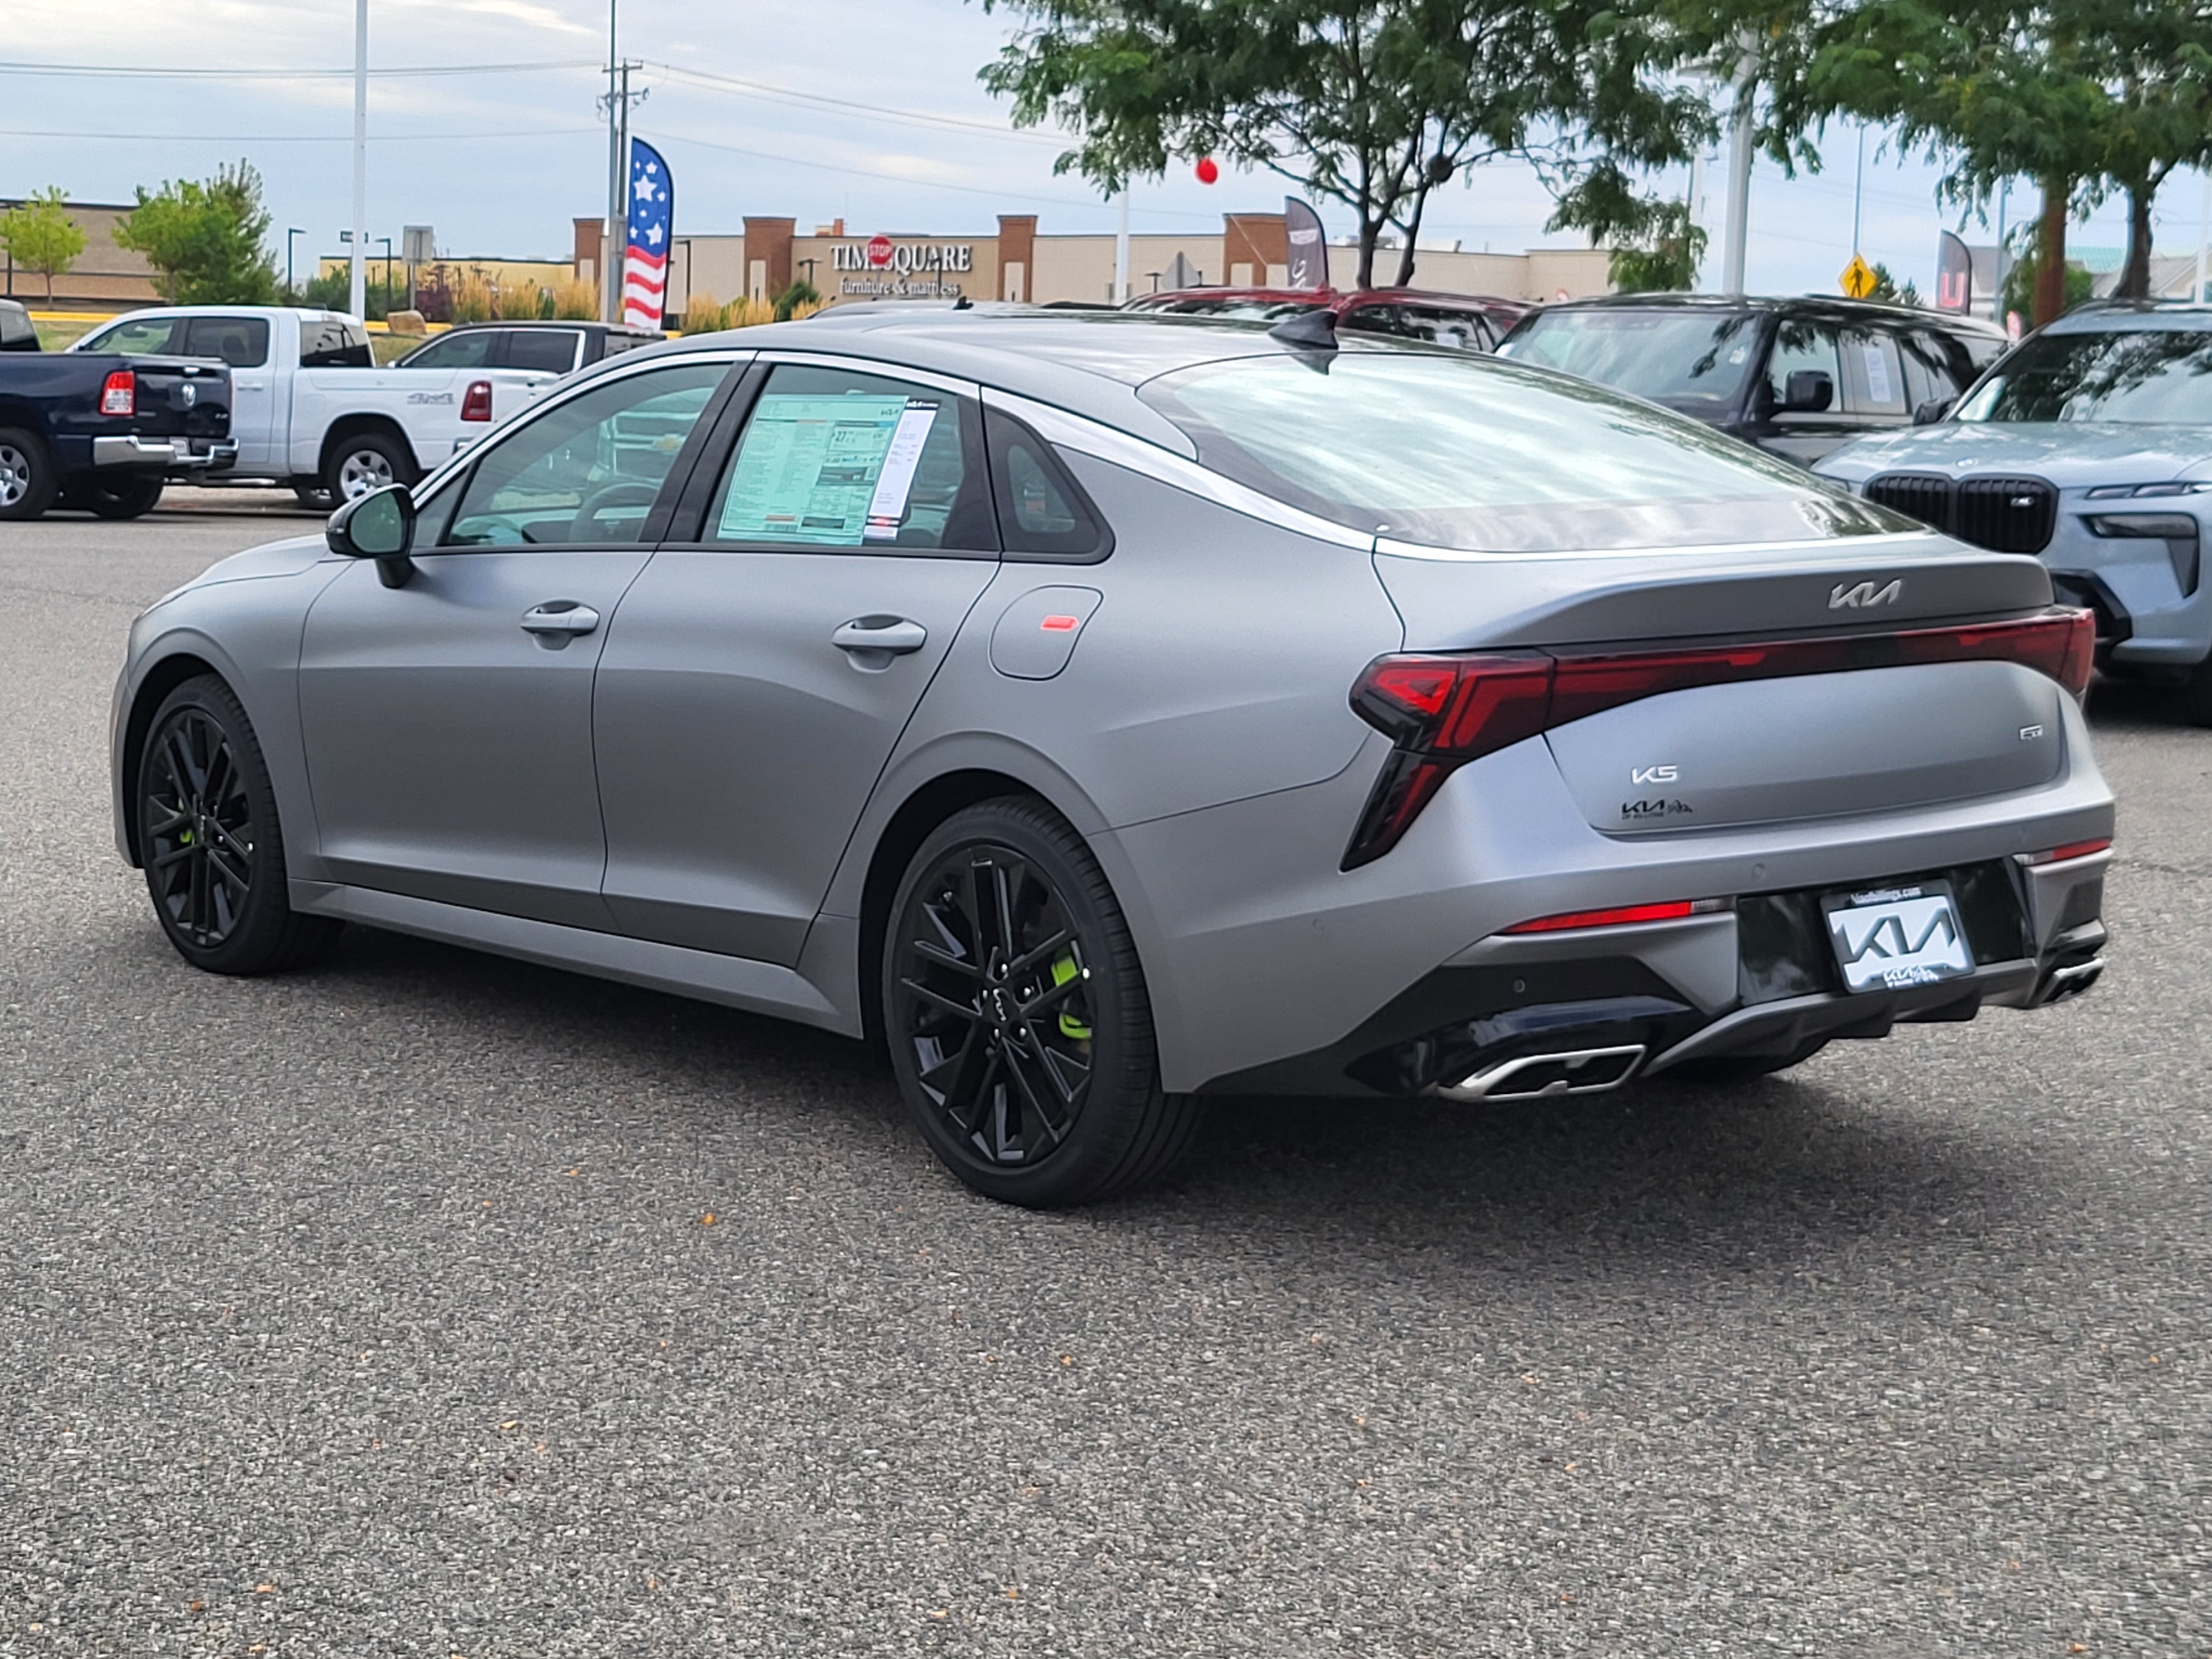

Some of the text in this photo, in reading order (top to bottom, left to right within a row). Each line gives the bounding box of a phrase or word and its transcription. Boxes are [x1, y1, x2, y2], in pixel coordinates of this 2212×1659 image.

[831, 245, 883, 270] TIM
[869, 244, 892, 257] STOP
[840, 278, 890, 294] furniture
[909, 280, 961, 295] mattess
[1828, 580, 1901, 608] KIA
[1632, 765, 1678, 784] K5
[1622, 800, 1665, 813] KIA
[1832, 908, 1956, 962] KIA
